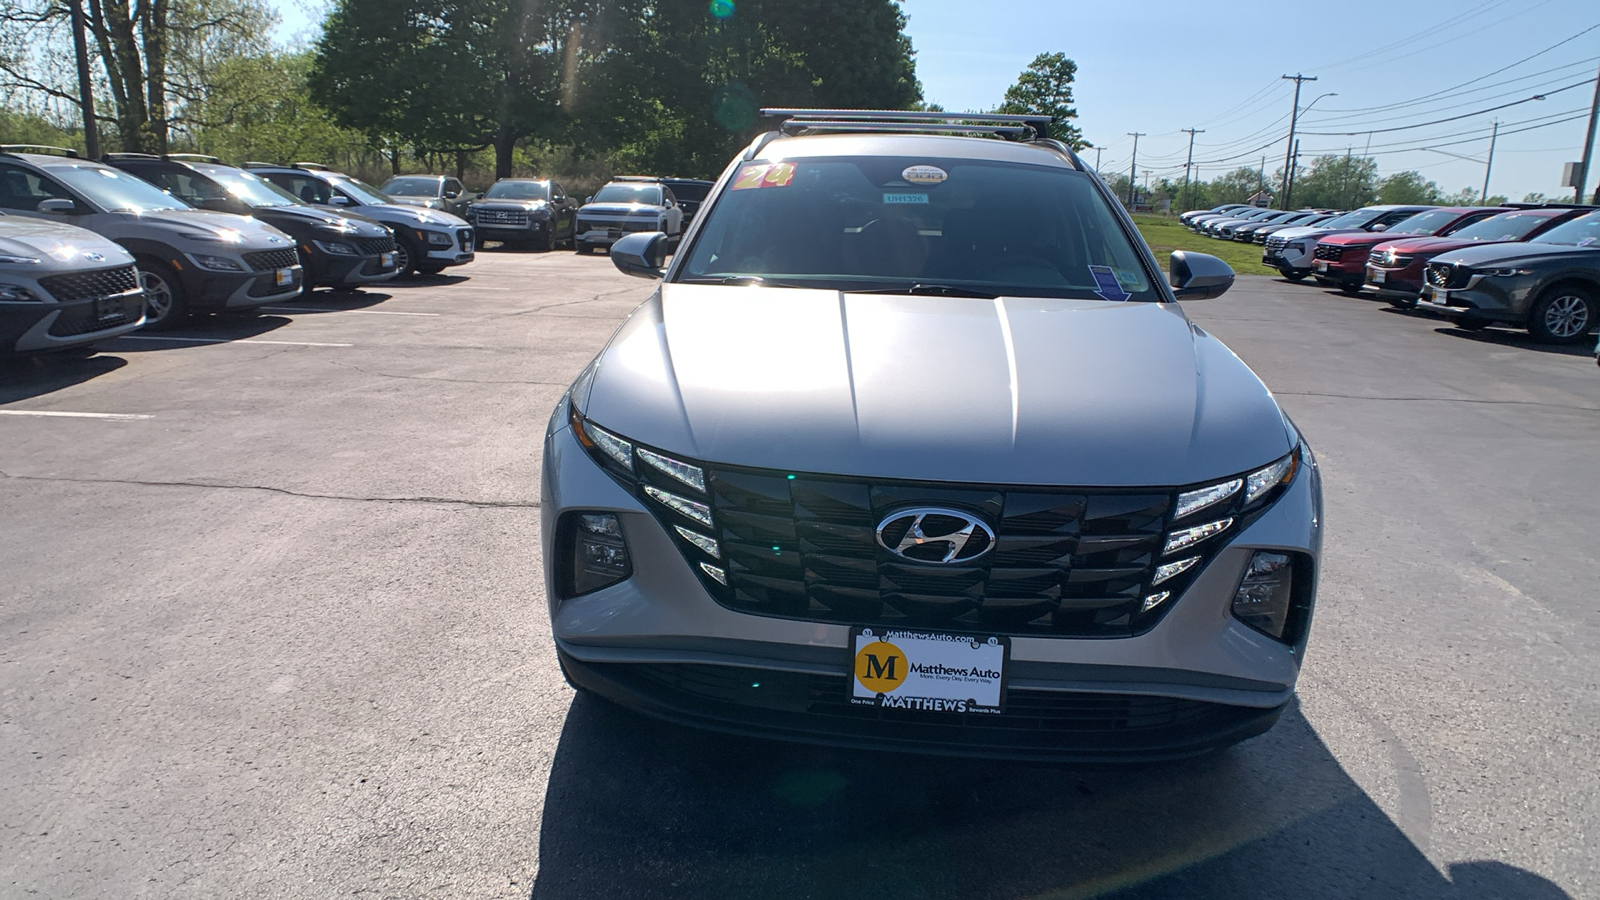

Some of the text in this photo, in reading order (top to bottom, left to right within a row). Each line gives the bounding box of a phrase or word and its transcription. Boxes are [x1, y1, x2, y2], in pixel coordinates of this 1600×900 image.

[734, 163, 795, 188] 24
[887, 194, 924, 203] UH1326
[885, 630, 975, 644] MatthewsAuto.com
[863, 653, 899, 681] M
[910, 662, 1001, 679] Matthews Auto
[935, 674, 952, 682] Every
[862, 698, 875, 706] Price
[881, 695, 967, 713] MATTHEWS
